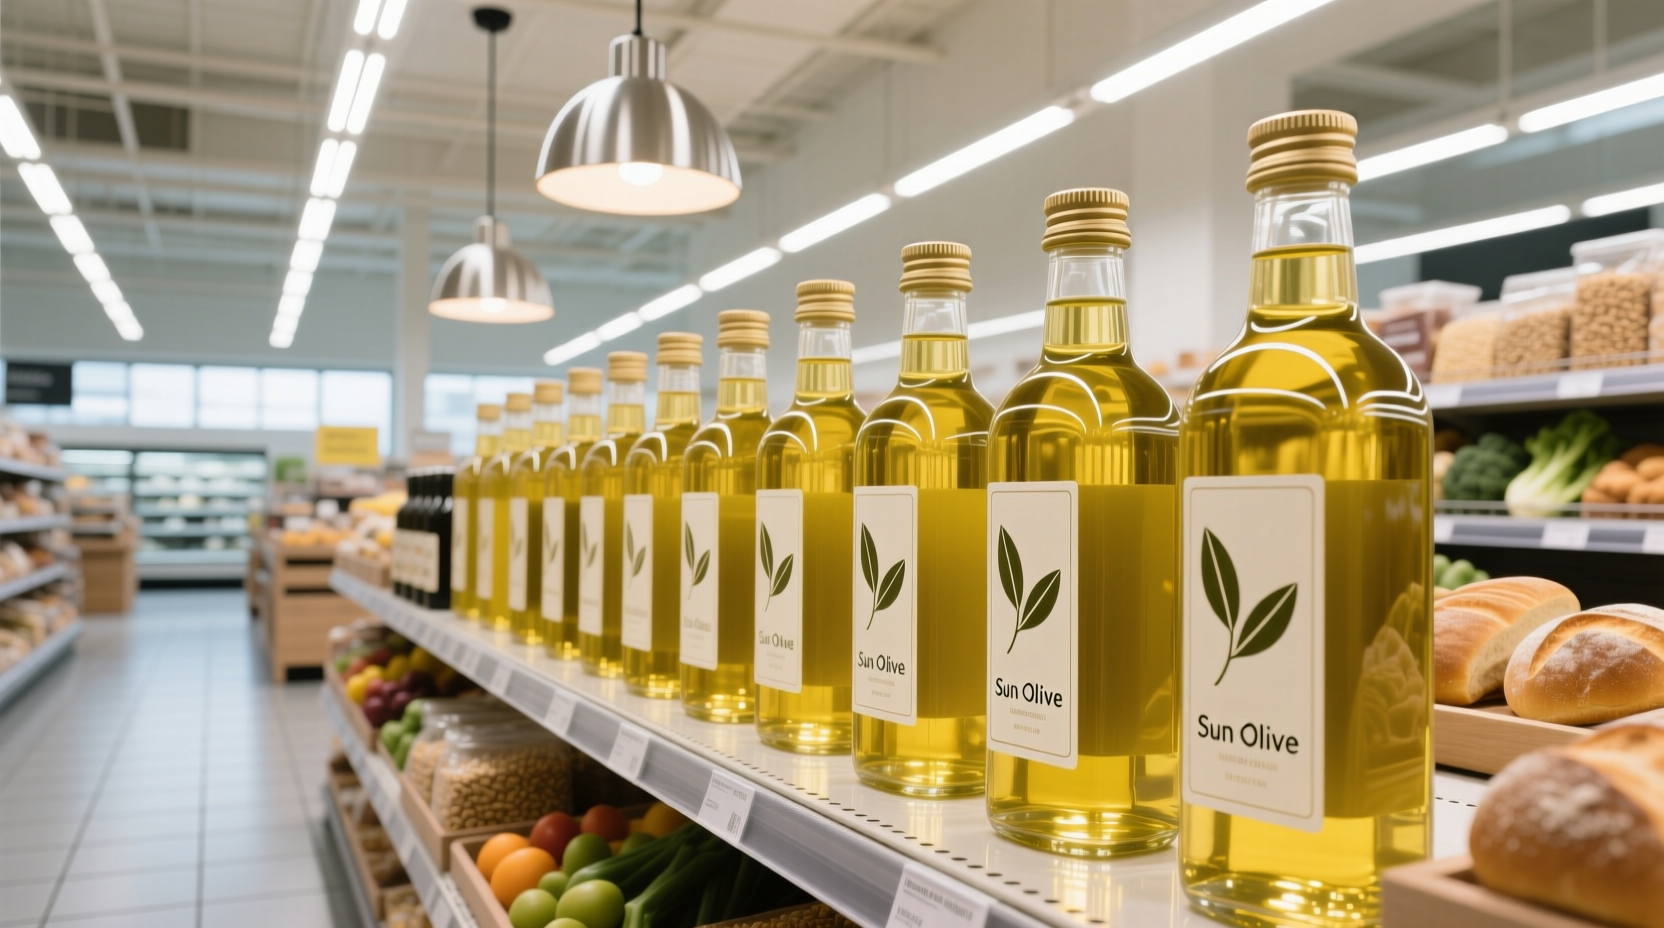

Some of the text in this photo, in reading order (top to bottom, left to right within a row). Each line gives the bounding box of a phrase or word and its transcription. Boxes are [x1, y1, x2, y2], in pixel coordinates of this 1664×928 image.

[857, 651, 905, 676] Sun Olive
[995, 677, 1063, 708] Sun Olive
[1198, 714, 1299, 755] Sun Olive
